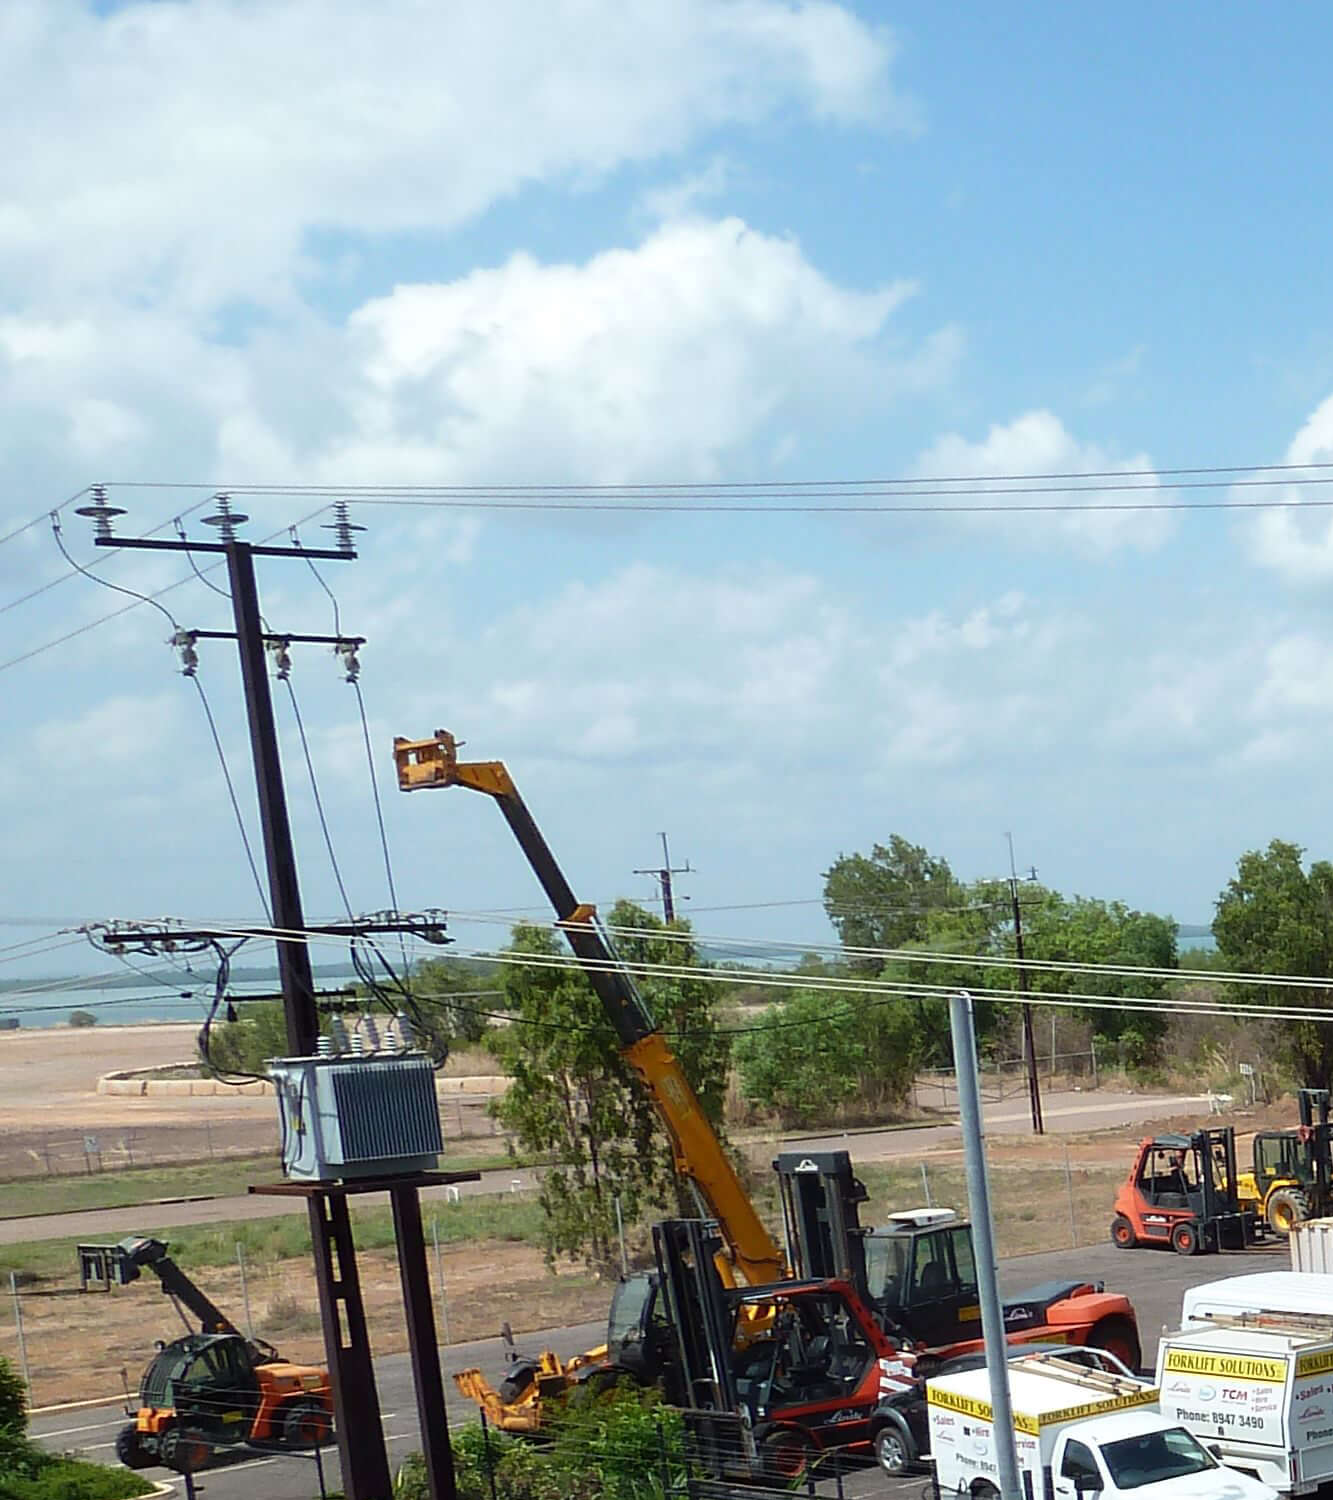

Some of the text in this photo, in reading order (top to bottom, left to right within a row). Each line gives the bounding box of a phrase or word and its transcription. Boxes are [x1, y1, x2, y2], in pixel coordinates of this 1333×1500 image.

[1168, 1353, 1216, 1372] FORKLIFT
[1219, 1359, 1276, 1377] SOLUTIONS
[932, 1389, 974, 1412] FORKLIFT
[1222, 1389, 1248, 1400] TCM
[1301, 1384, 1324, 1400] Sales
[1042, 1405, 1091, 1422] FORKLIFT
[1176, 1408, 1264, 1429] Phone: 8947 3490
